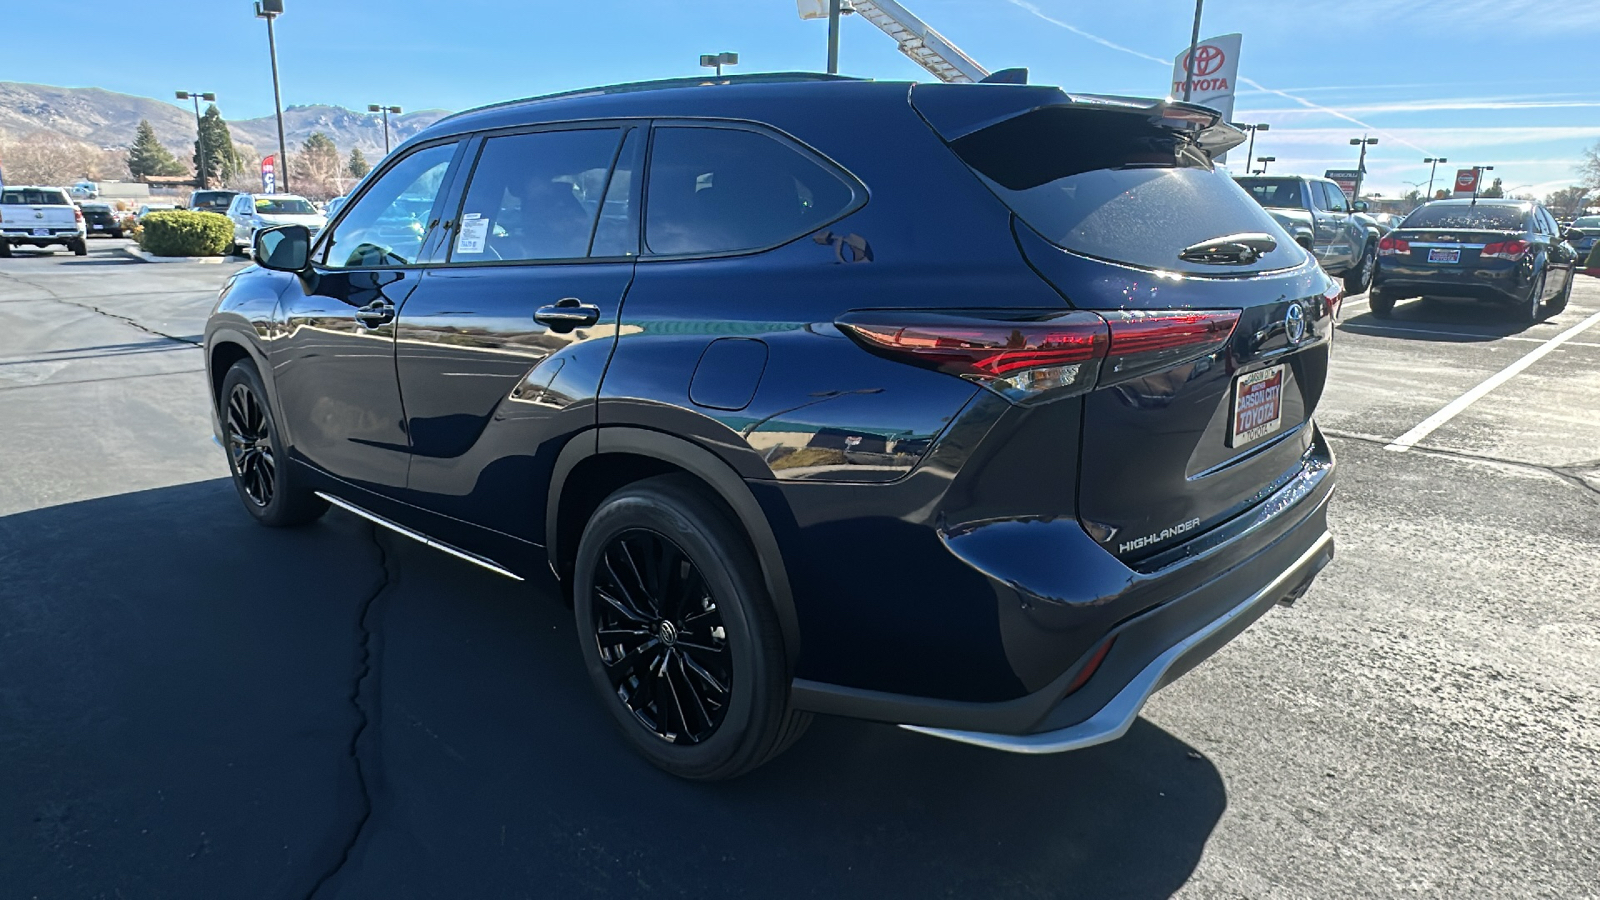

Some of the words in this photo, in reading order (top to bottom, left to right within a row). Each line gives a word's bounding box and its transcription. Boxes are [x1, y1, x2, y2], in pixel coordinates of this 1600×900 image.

[1237, 390, 1265, 412] CARSON
[1265, 384, 1280, 401] CITY
[1240, 402, 1274, 431] TOYOTA
[1247, 424, 1268, 440] TOYOTA
[1119, 517, 1200, 553] HIGHLANDER
